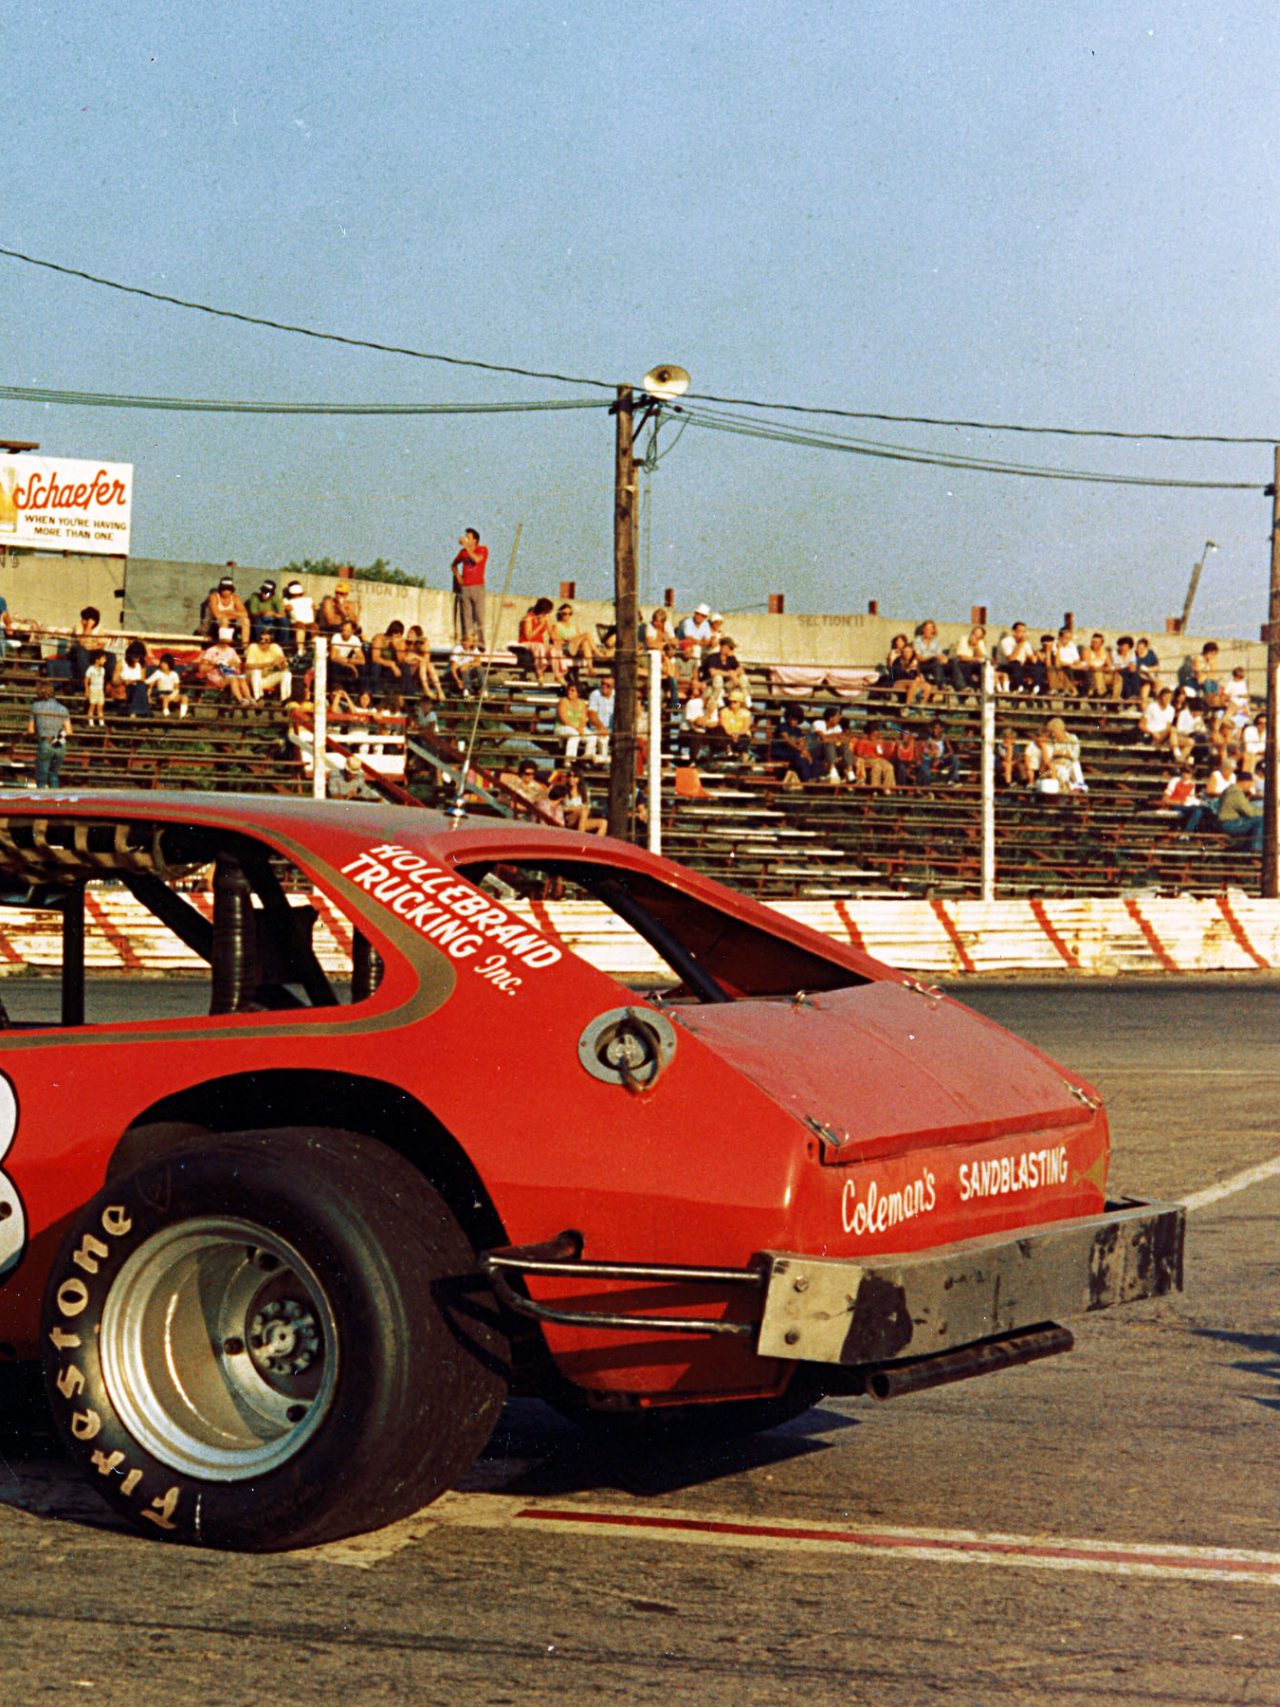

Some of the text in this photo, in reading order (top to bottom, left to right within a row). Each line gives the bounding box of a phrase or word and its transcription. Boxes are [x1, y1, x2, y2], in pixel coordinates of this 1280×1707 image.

[12, 469, 126, 510] Schaefer
[24, 515, 127, 531] WHEN YOU'RE HAVING
[34, 526, 61, 537] MORE
[66, 529, 91, 540] THAN
[94, 531, 114, 541] ONE
[340, 852, 523, 996] TRUCKING Inc.
[370, 844, 562, 969] HOLLEBRAND
[841, 1146, 1069, 1236] Coleman's SANDBLASTING
